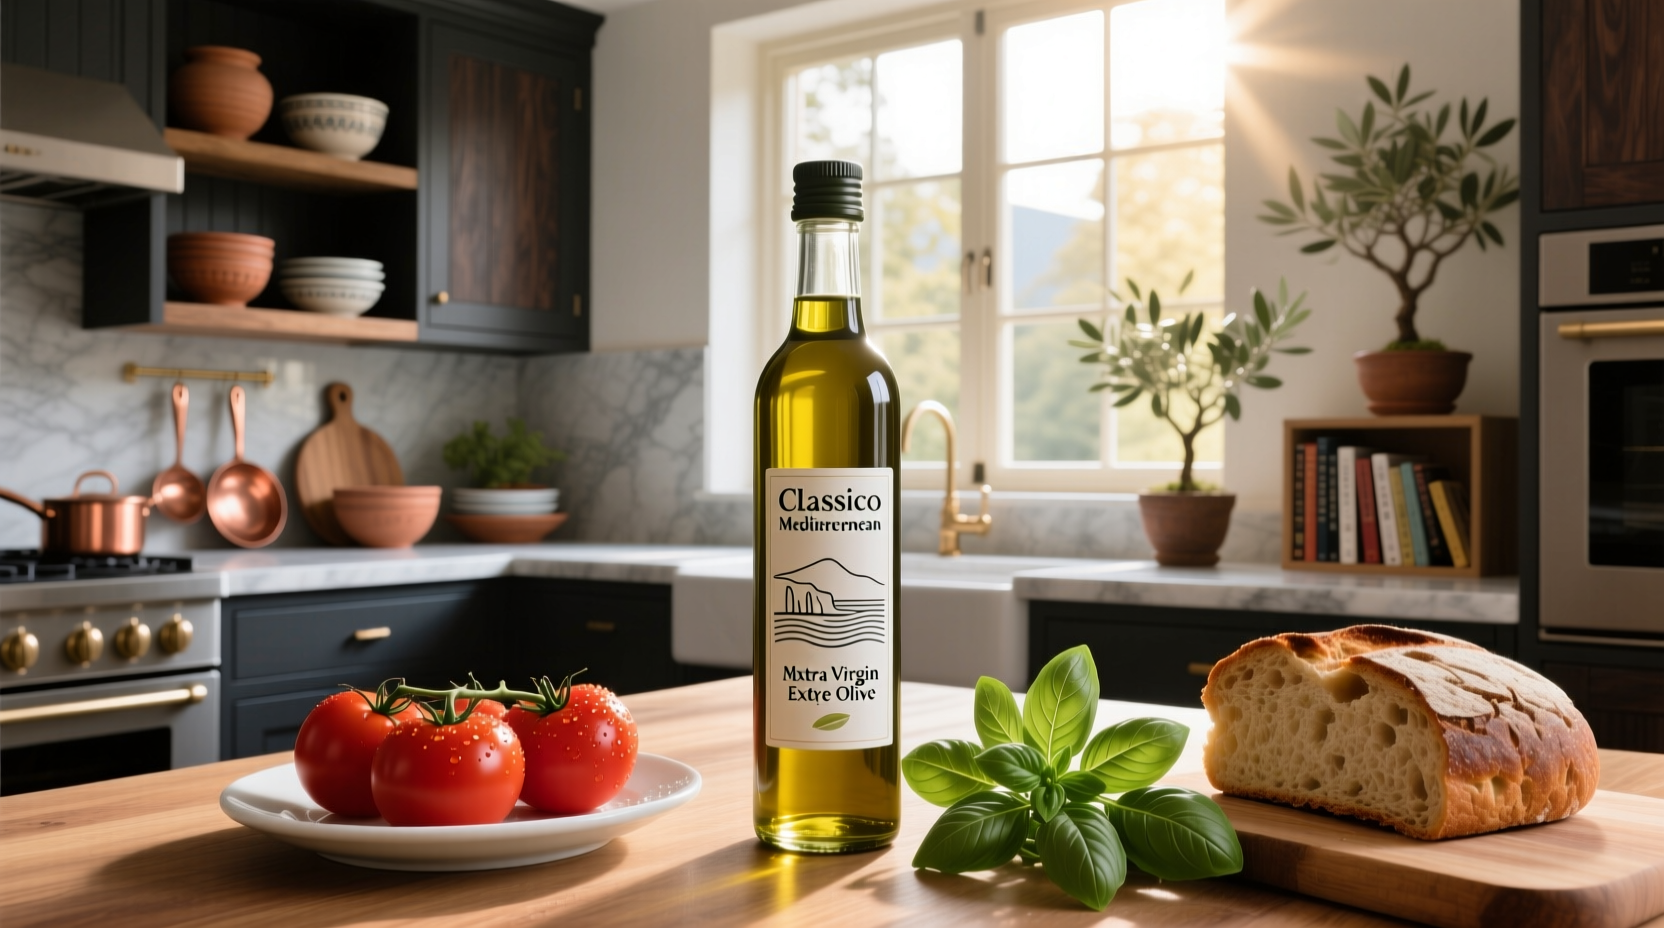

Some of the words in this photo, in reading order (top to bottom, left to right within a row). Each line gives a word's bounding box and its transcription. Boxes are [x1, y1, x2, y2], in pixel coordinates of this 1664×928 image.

[778, 487, 882, 512] Classico
[831, 665, 879, 686] Virgin
[836, 685, 876, 702] Olive
